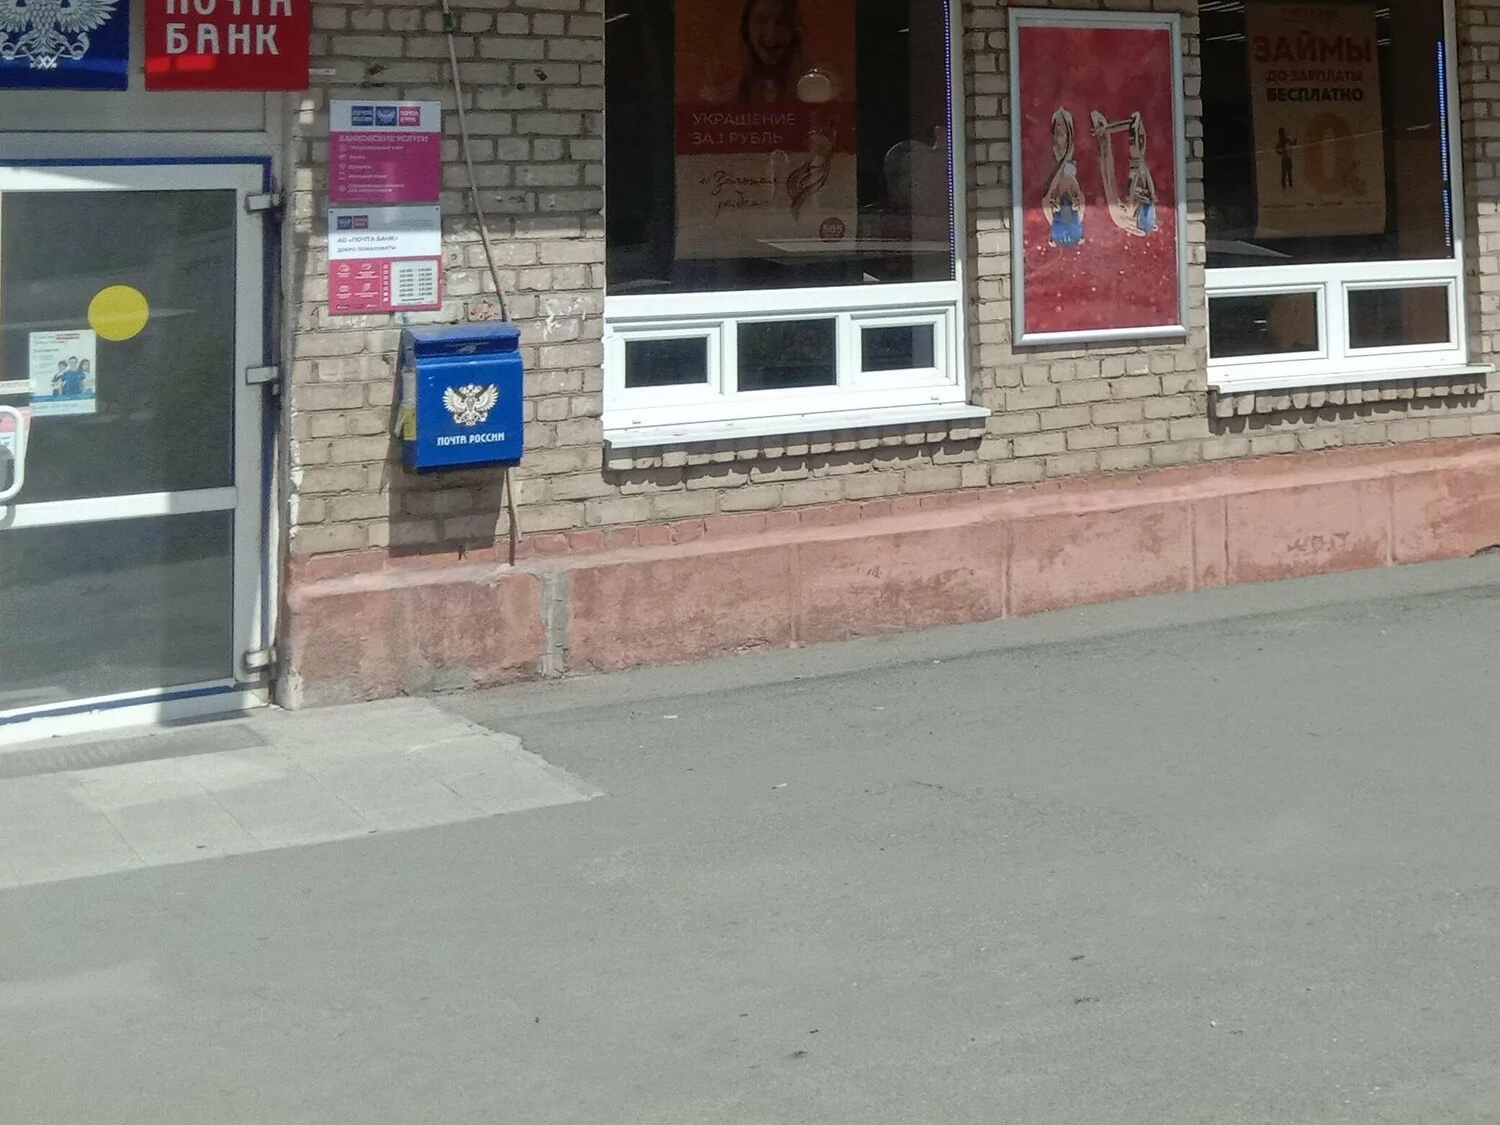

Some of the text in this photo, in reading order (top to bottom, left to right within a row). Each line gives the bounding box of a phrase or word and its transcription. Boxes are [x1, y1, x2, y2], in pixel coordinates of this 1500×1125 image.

[166, 23, 280, 56] БАНК
[1253, 30, 1372, 63] ЗАЙМЫ
[1266, 87, 1364, 103] БЕСПЛАТНО
[692, 112, 798, 126] УКРАШЕНИЕ
[692, 131, 713, 146] ЗА
[729, 131, 784, 145] РУБЛЬ
[437, 432, 505, 446] ПОЧТА РОССИИ
